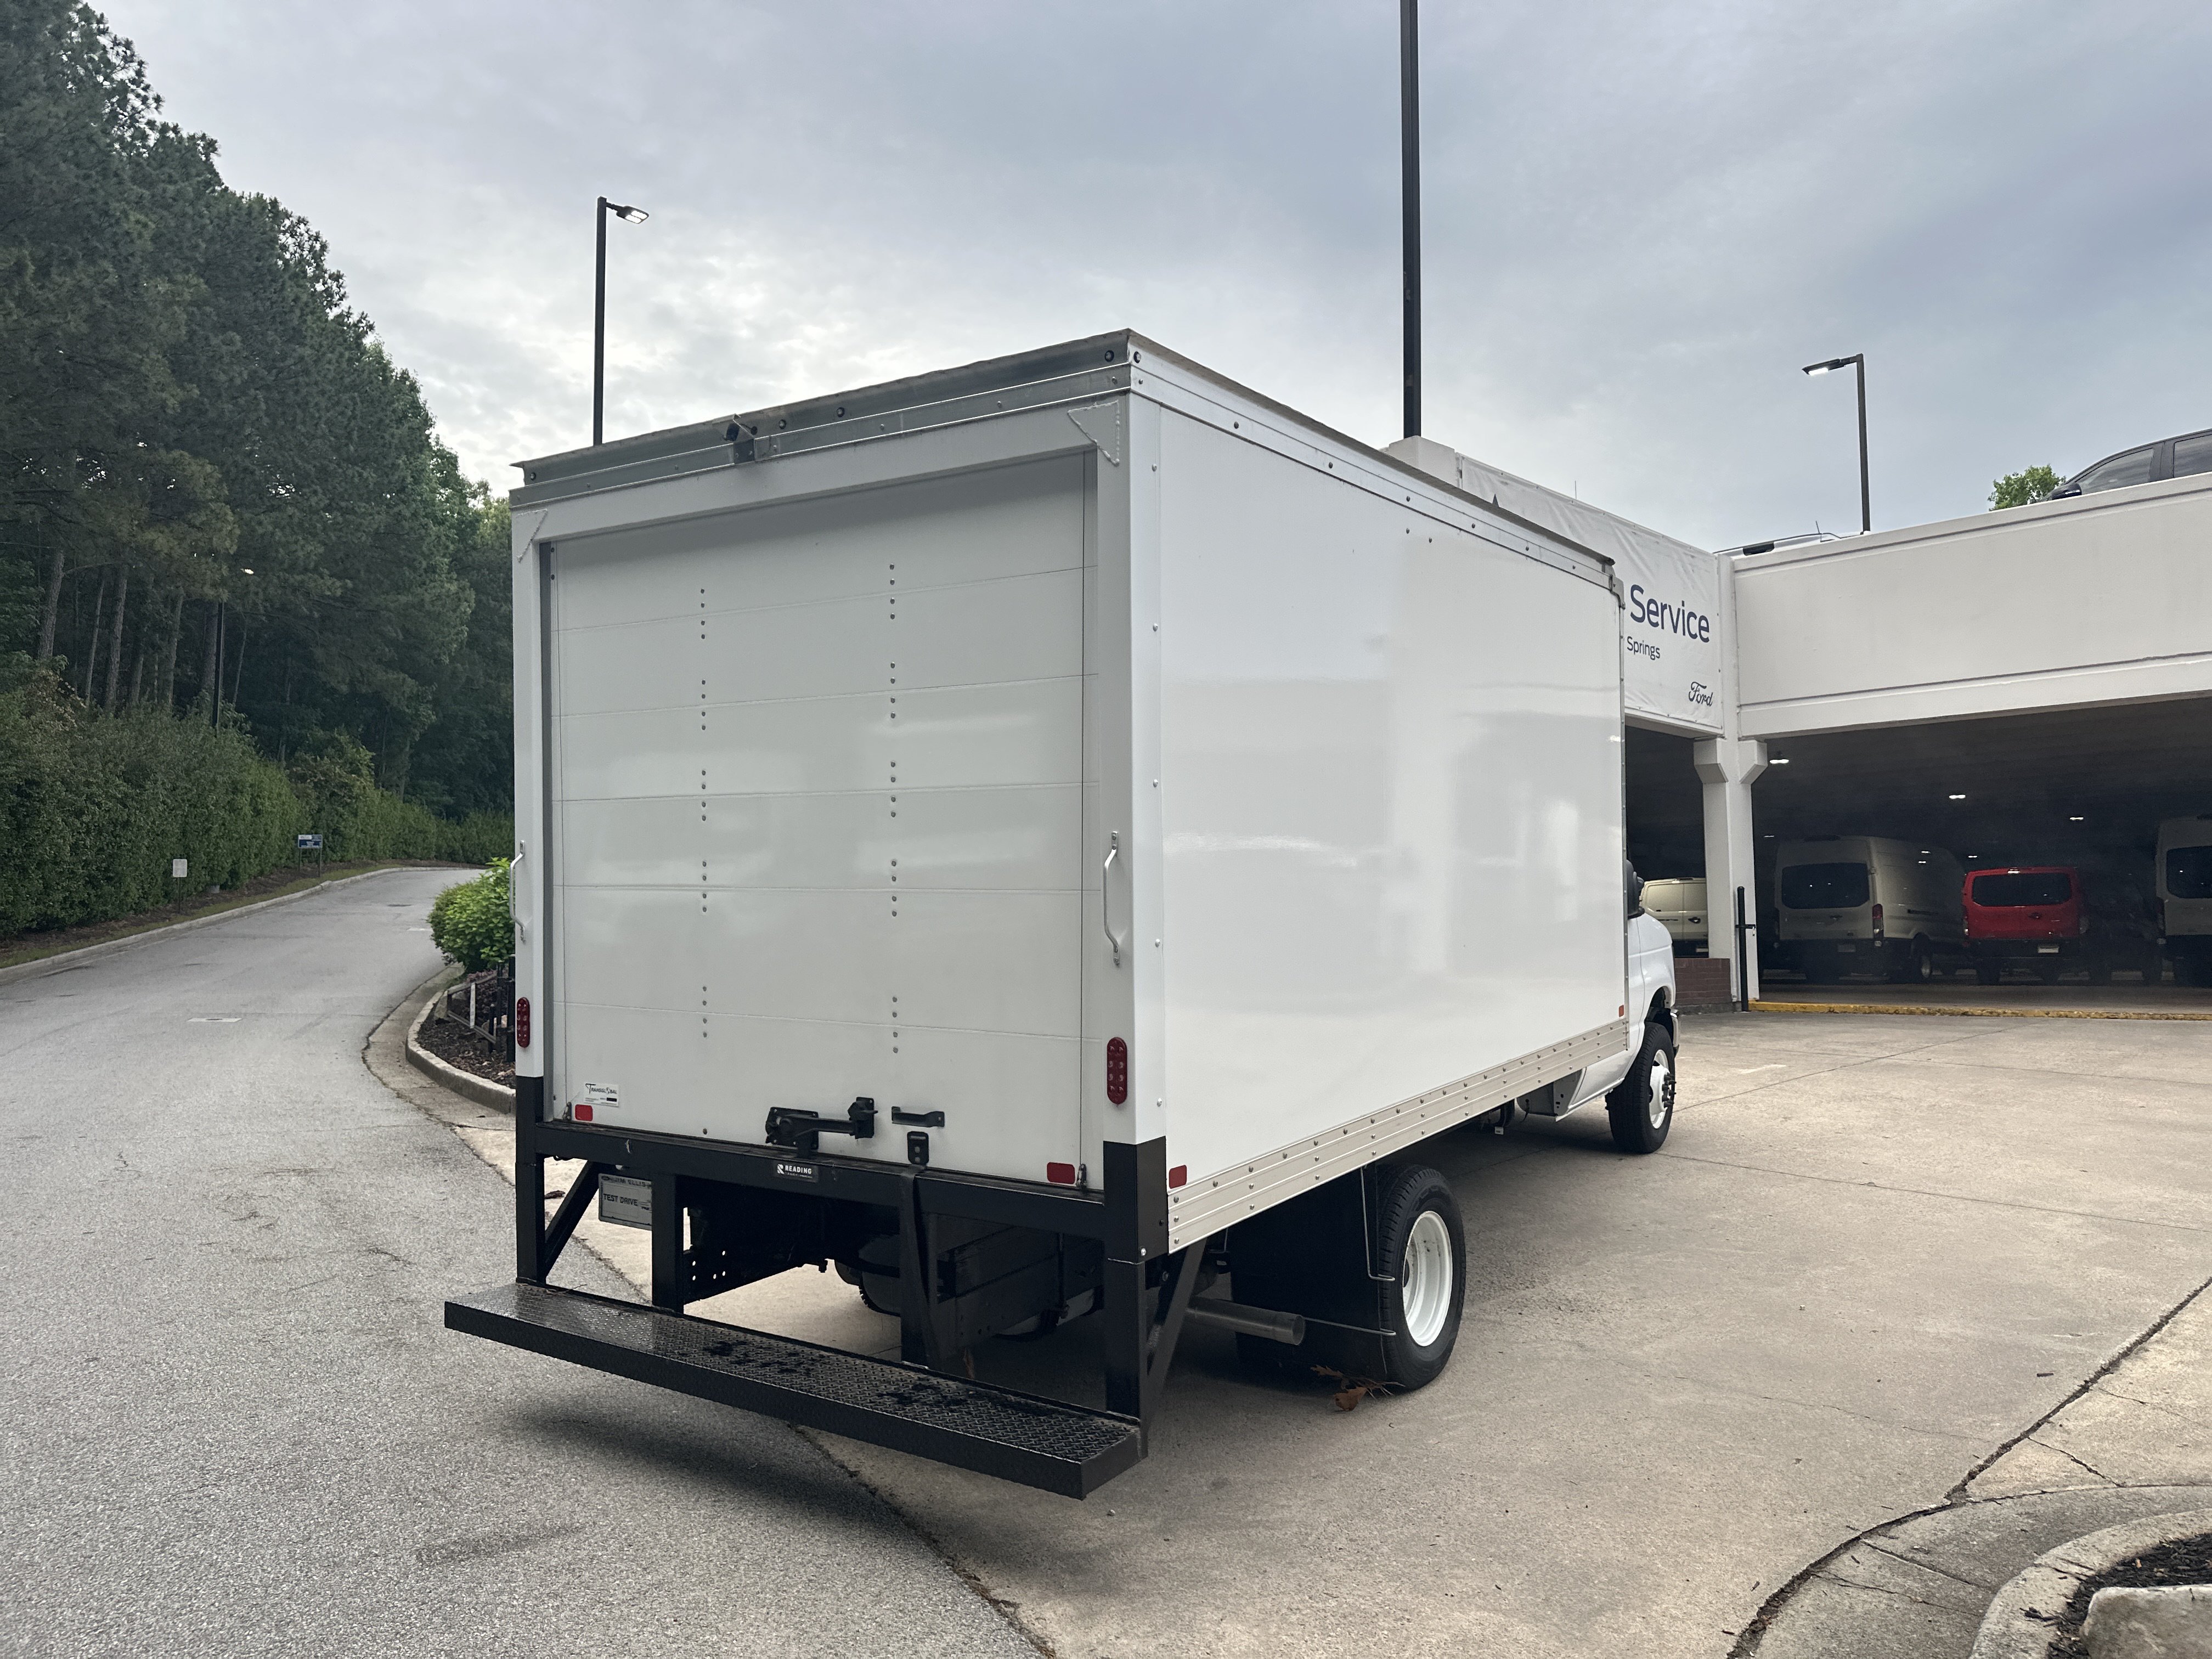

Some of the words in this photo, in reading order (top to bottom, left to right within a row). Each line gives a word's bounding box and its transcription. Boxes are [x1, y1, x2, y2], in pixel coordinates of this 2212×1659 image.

[1630, 584, 1710, 643] Service
[1627, 636, 1661, 661] Springs
[1688, 681, 1713, 707] Ford
[785, 1165, 812, 1174] READING
[603, 1193, 618, 1202] TEST
[619, 1197, 638, 1206] DRIVE
